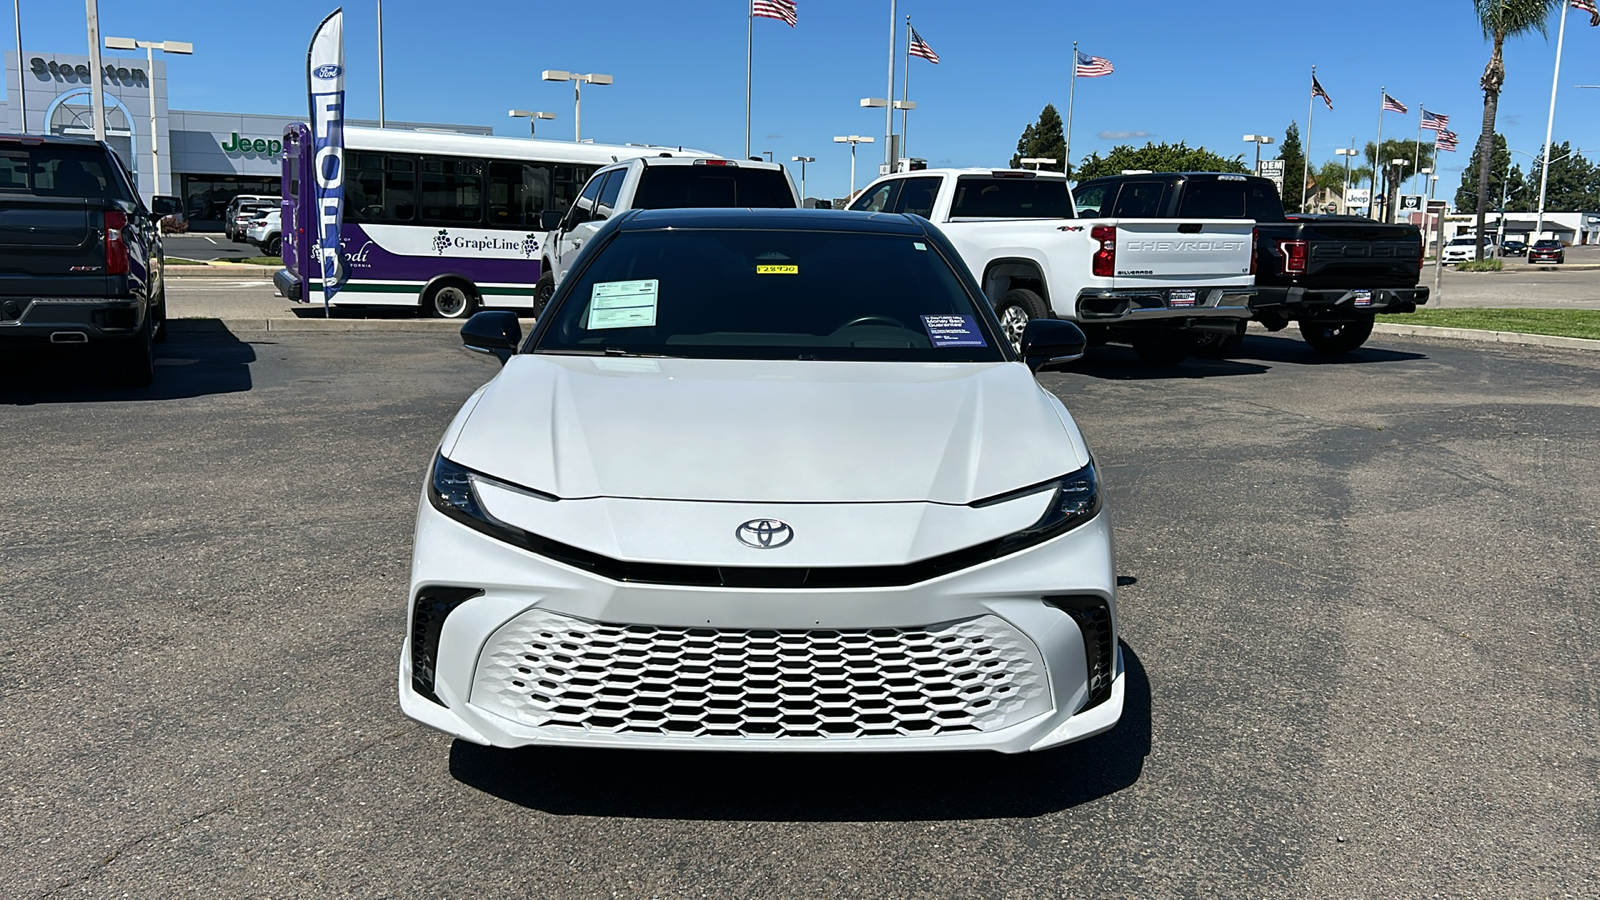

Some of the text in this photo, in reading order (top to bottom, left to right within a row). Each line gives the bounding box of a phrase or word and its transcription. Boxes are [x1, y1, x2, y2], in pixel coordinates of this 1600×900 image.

[30, 57, 149, 82] Stocton
[319, 66, 338, 78] Ford
[221, 132, 282, 157] Jeep
[1261, 161, 1283, 170] OEM
[1347, 195, 1369, 204] Jeep
[454, 236, 519, 251] GrapeLine
[1127, 241, 1245, 252] CHEVROLET
[340, 240, 374, 262] odi
